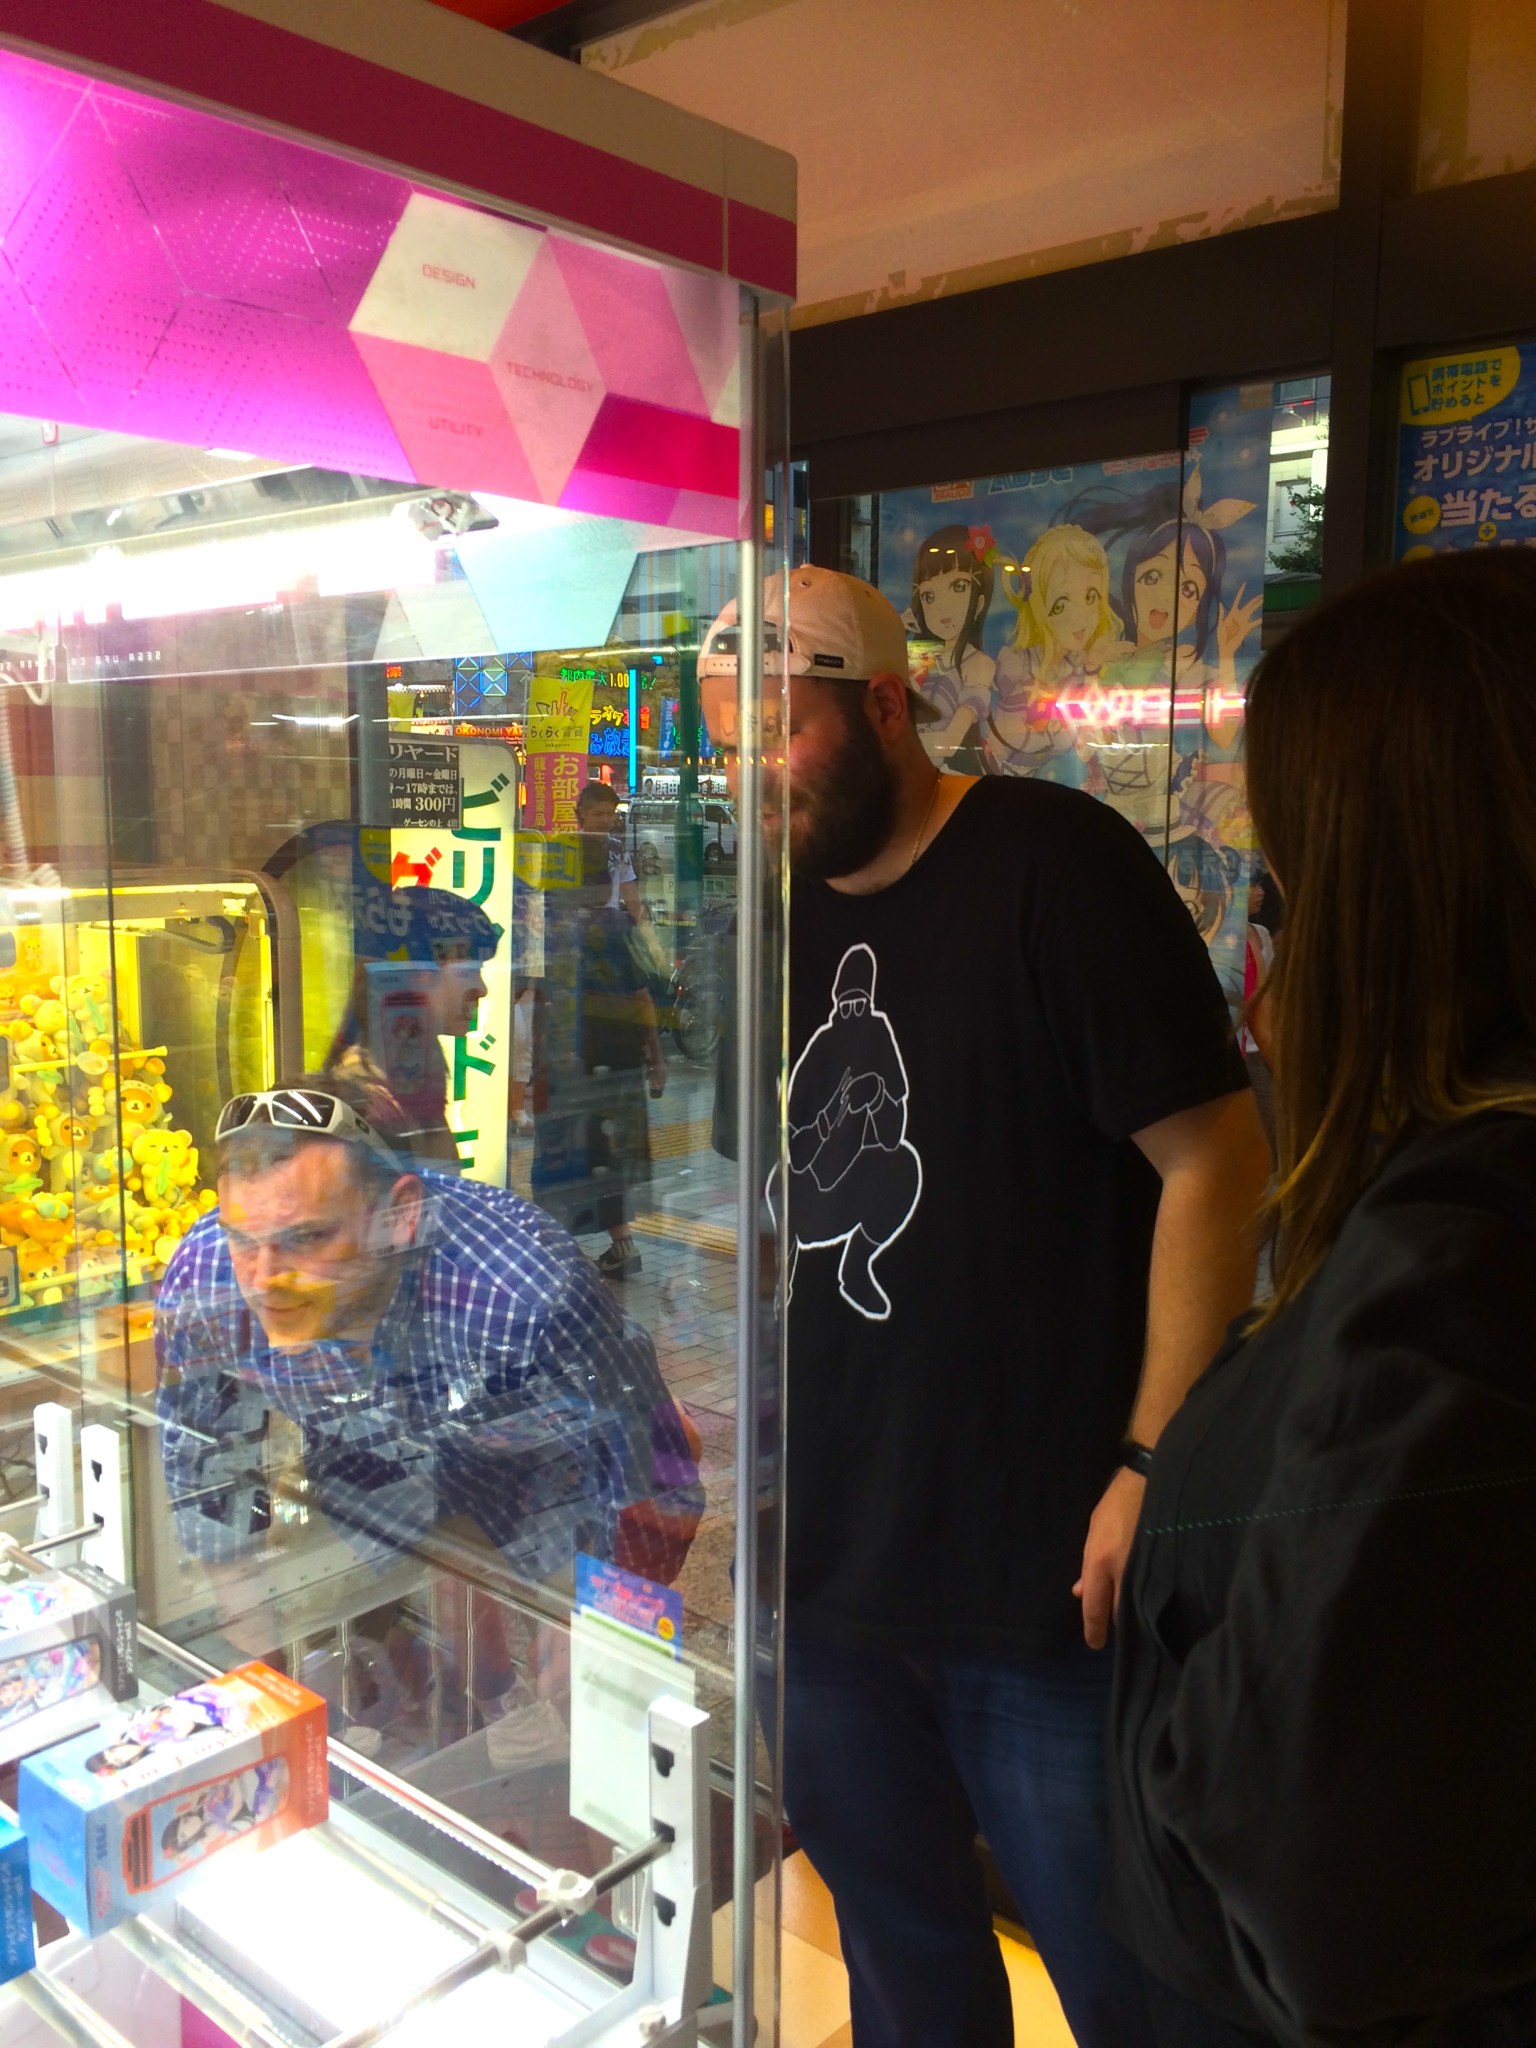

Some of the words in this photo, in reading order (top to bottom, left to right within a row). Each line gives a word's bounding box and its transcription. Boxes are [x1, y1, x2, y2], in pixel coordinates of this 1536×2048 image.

[422, 263, 476, 289] DESIGN
[506, 361, 595, 393] TECHNOLOGY
[1432, 374, 1502, 395] ポイントを
[429, 416, 485, 438] UTILITY
[455, 726, 503, 737] OKONOMI
[415, 796, 456, 813] 300円
